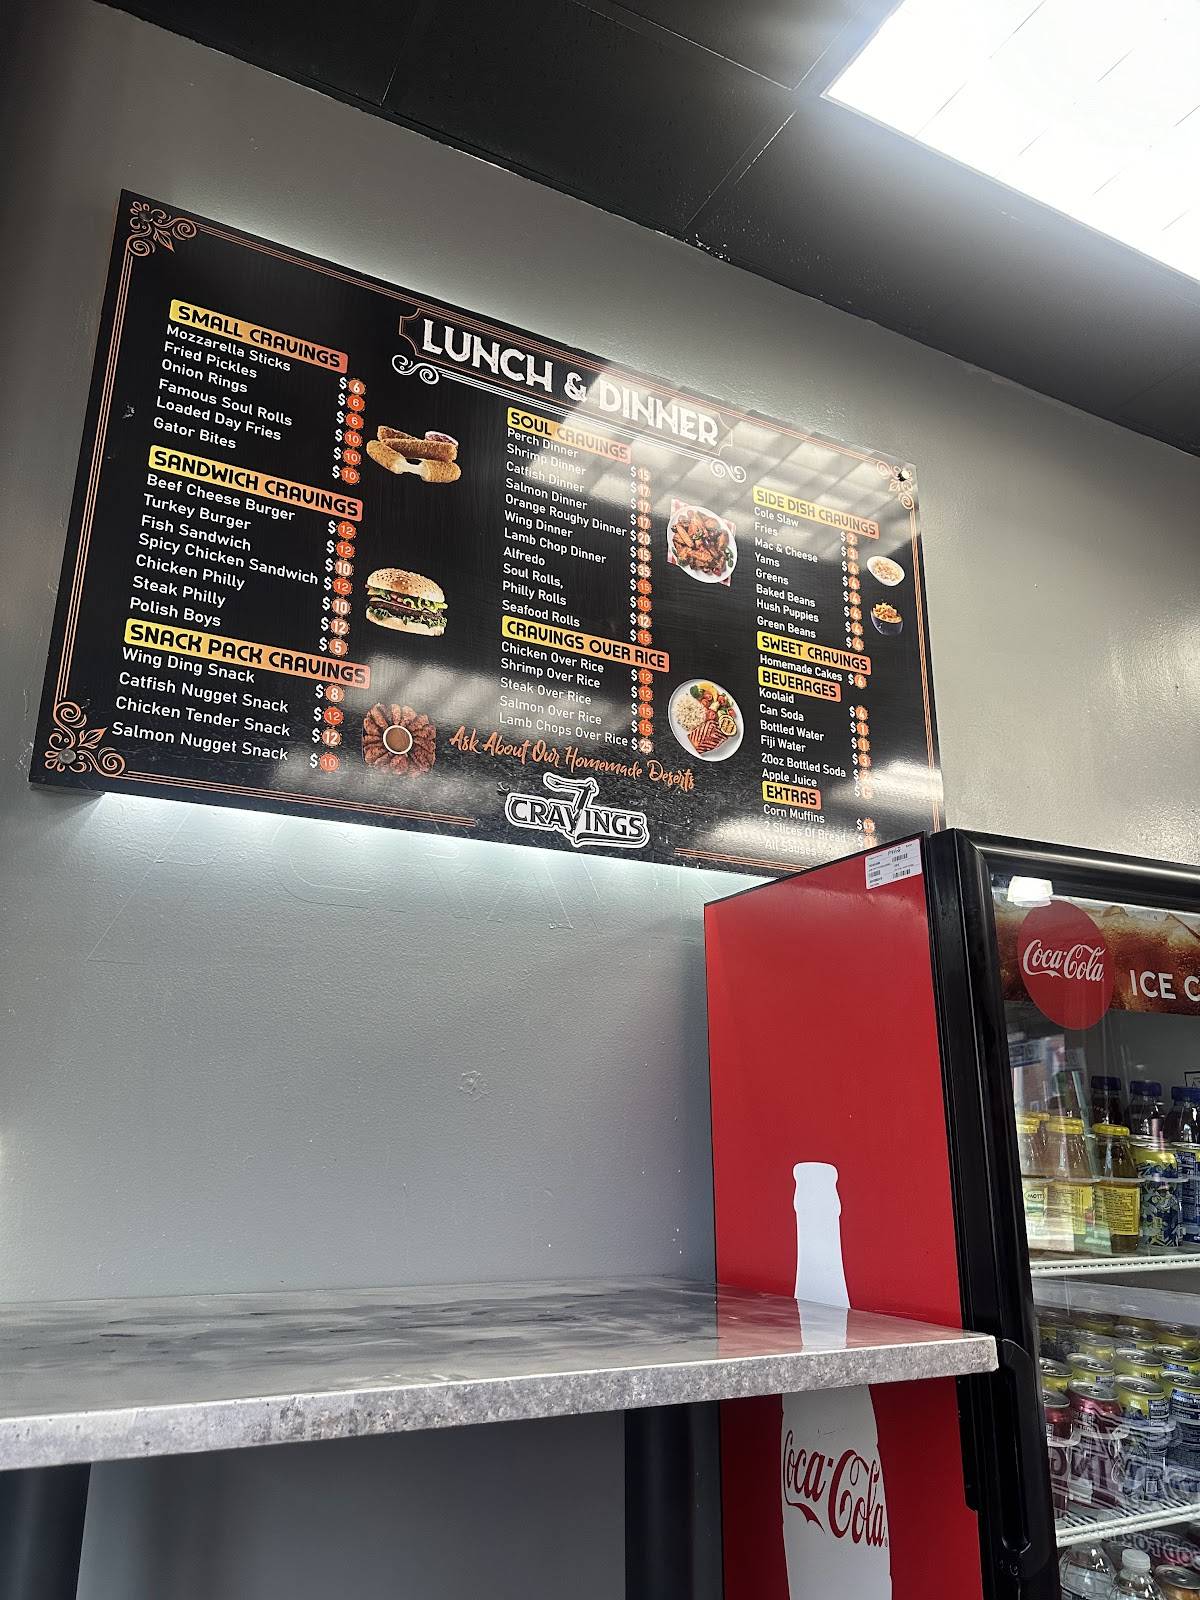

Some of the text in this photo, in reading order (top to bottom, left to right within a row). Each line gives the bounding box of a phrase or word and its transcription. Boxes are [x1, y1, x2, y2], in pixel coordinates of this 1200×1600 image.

[166, 323, 291, 372] Mozzarella Sticks
[177, 305, 340, 368] SMALL CRAVINGS
[164, 340, 257, 378] Fried Pickles
[161, 358, 248, 395] Onion Rings
[421, 318, 719, 448] LUNCH & DINNER
[158, 377, 292, 426] Famous Soul Rolls
[153, 416, 236, 449] Gator Bites
[156, 396, 281, 441] Loaded Day Fries
[507, 427, 578, 458] Perch Dinner
[510, 411, 627, 460] SOUL CRAVINGS
[506, 442, 586, 476] Shrimp Dinner
[153, 449, 359, 517] SANDWICH CRAVINGS
[506, 460, 584, 493] Catfish Dinner
[146, 473, 295, 523] Beef Cheese Burger
[506, 477, 587, 510] Salmon Dinner
[142, 493, 251, 533] Turkey Burger
[504, 510, 573, 538] Wing Dinner
[505, 493, 626, 537] Orange Roughy Dinner
[754, 506, 798, 527] Cole Slaw
[754, 521, 777, 537] Fries
[757, 489, 875, 536] SIDE DISH CRAVINGS
[141, 514, 251, 551] Fish Sandwich
[504, 527, 606, 564] Lamb Chop Dinner
[138, 532, 318, 585] Spicy Chicken Sandwich
[503, 545, 545, 566] Alfredo
[754, 536, 817, 563] Mac & Cheese
[755, 552, 780, 568] Yams
[135, 553, 245, 591] Chicken Philly
[503, 563, 528, 579] Soul
[755, 567, 788, 585] Greens
[132, 575, 225, 609] Steak Philly
[502, 580, 566, 606] Philly Rolls
[756, 583, 815, 608] Baked Beans
[130, 597, 221, 629] Polish Boys
[502, 599, 579, 627] Seafood Rolls
[756, 598, 819, 625] Hush Puppies
[757, 615, 816, 639] Green Beans
[129, 623, 366, 684] SNACK PACK CRAVINGS
[501, 641, 603, 673] Chicken Over Rice
[507, 620, 664, 668] CRAVINGS OVER RICE
[762, 635, 867, 671] SWEET CRAVINGS
[121, 647, 255, 683] Wing Ding Snack
[500, 657, 600, 688] Shrimp Over Rice
[760, 653, 842, 682] Homemade Cakes
[118, 670, 289, 713] Catfish Nugget Snack
[500, 677, 591, 705] Steak Over Rice
[759, 687, 794, 704] Koolaid
[762, 670, 836, 698] BEVERAGES
[115, 695, 291, 737] Chicken Tender Snack
[500, 695, 601, 725] Salmon Over Rice
[759, 703, 804, 722] Can Soda
[111, 721, 288, 761] Salmon Nugget Snack
[499, 712, 627, 747] Lamb Chops Over Rice
[760, 719, 824, 742] Bottled Water
[760, 734, 805, 752] Fiji Water
[448, 724, 695, 793] Ask About Our Homemade Deserts
[761, 752, 846, 777] 20oz Bottled Soda
[761, 768, 817, 787] Apple Juice
[766, 784, 816, 805] EXTRAS
[508, 796, 645, 840] CRAVINGS
[763, 804, 824, 824] Corn Muffins
[1022, 939, 1106, 983] Coca-Cola
[1129, 969, 1176, 1000] ICE
[783, 1429, 886, 1548] Coca-Cola
